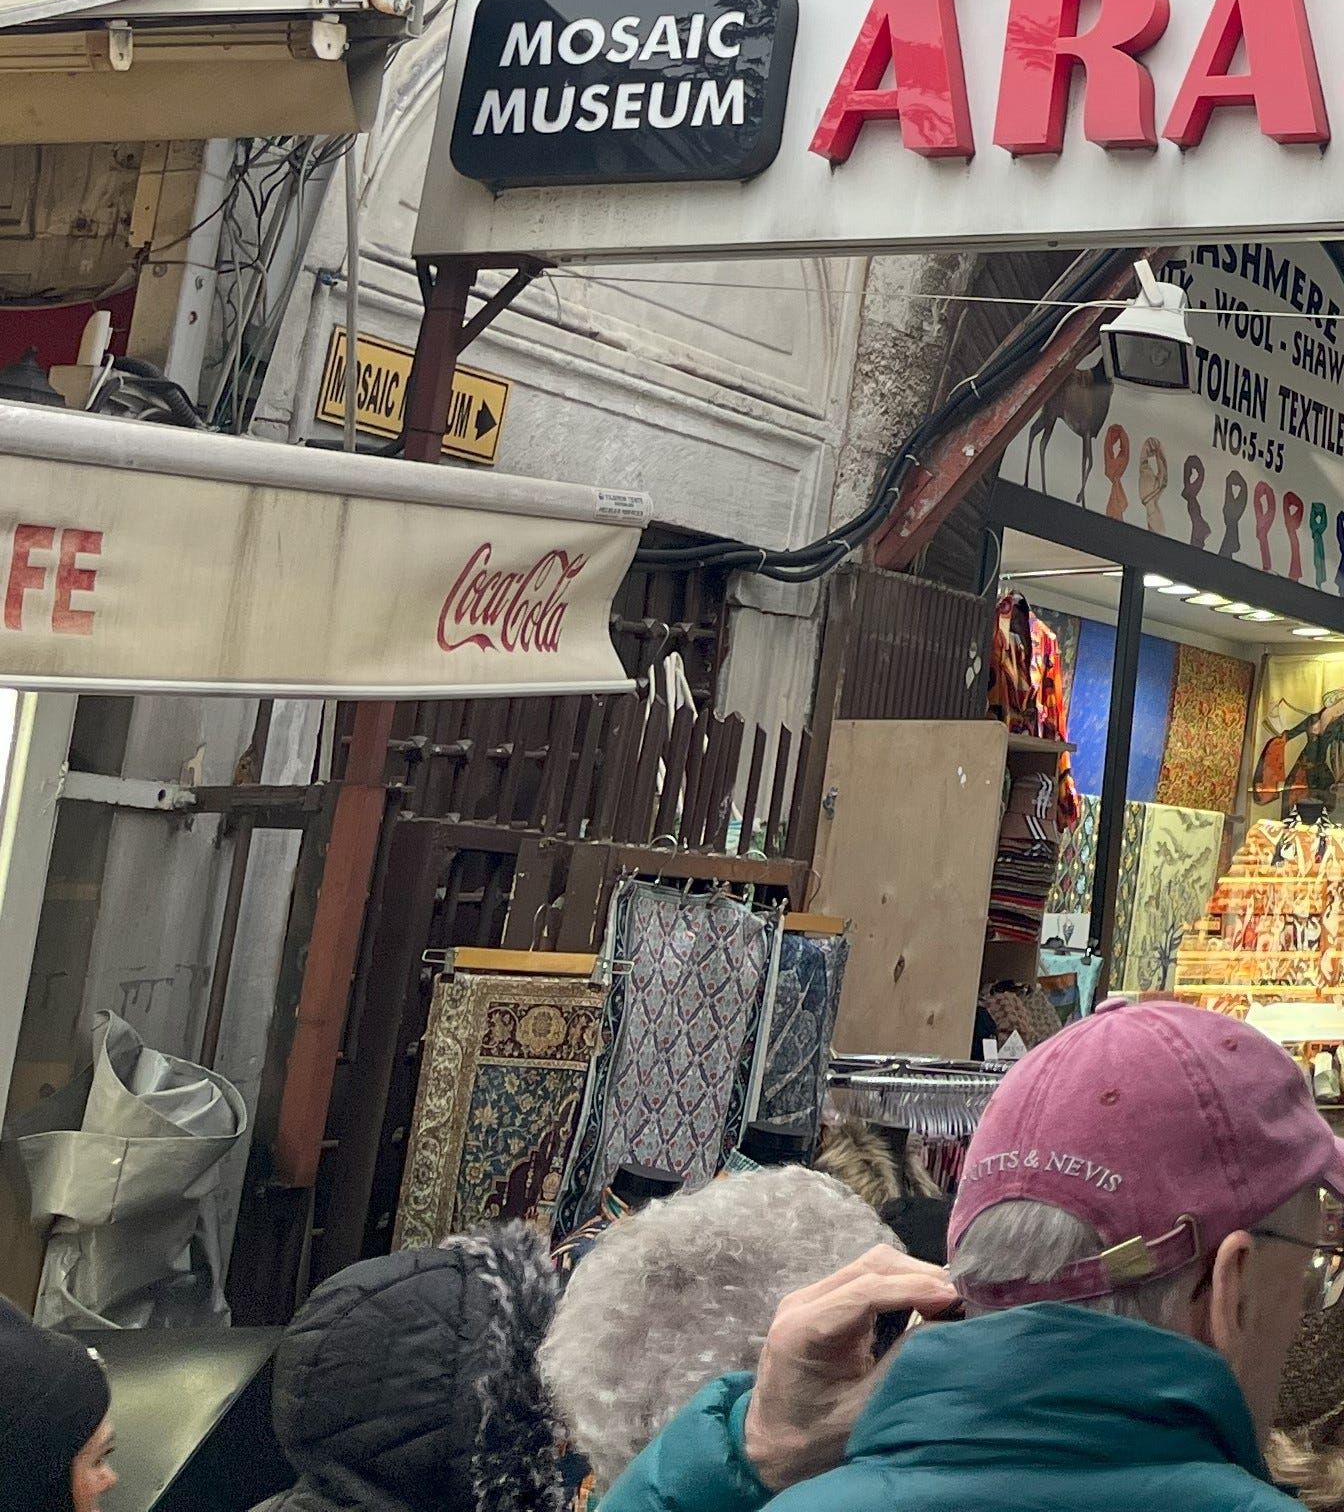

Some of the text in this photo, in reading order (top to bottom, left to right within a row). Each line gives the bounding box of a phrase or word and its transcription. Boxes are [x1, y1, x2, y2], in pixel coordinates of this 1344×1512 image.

[499, 10, 746, 68] MOSAIC
[472, 78, 745, 136] MUSEUM
[1191, 243, 1341, 345] ASHMERE
[1214, 287, 1273, 354] WOOL
[1195, 345, 1269, 424] TOLIAN
[1023, 1149, 1040, 1168] &
[1044, 1151, 1123, 1193] NEVIS
